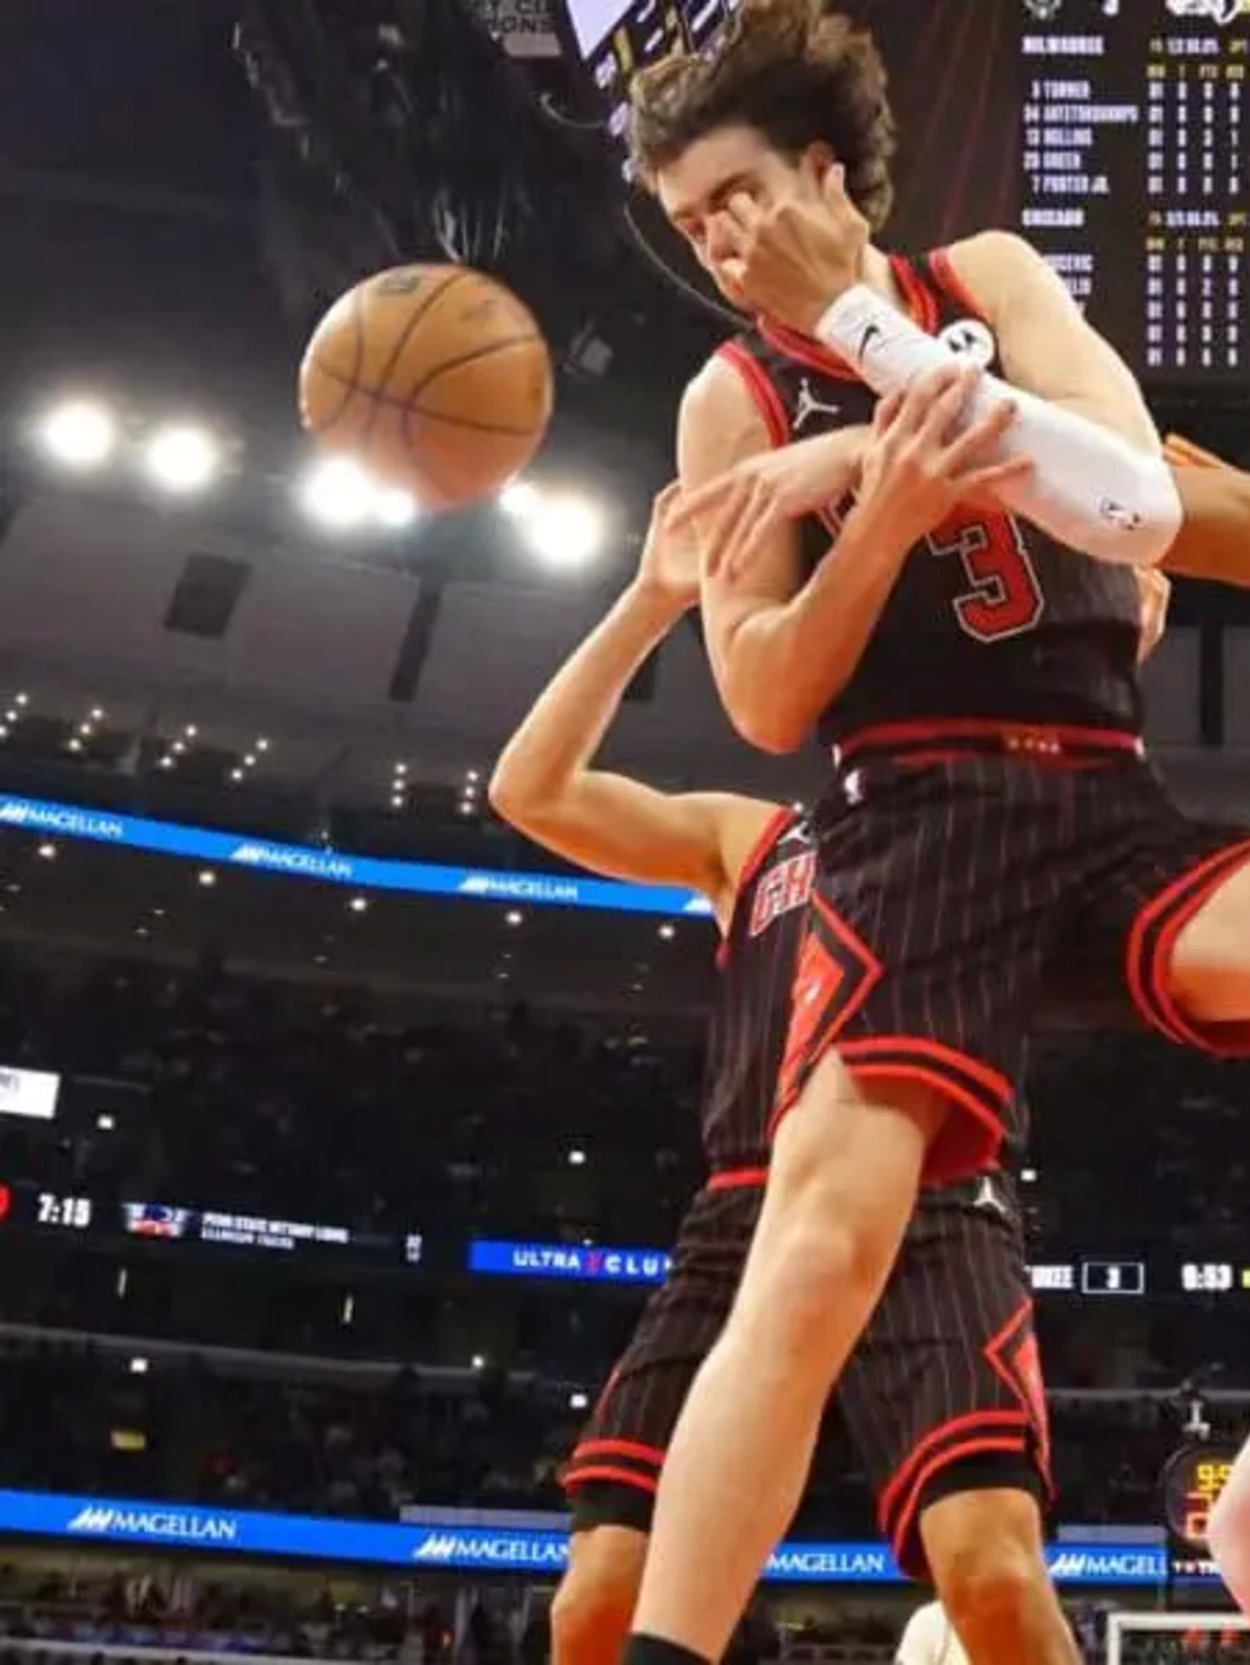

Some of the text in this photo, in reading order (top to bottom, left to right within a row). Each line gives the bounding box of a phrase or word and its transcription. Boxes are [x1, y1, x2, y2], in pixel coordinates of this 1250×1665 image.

[1022, 36, 1104, 54] MILWAUKEE
[1043, 81, 1090, 98] TURNER
[1043, 105, 1139, 122] ANTETOMPO
[1022, 209, 1084, 226] CHICAGO
[925, 500, 1045, 643] 3
[28, 807, 124, 836] MAGELLAN
[261, 847, 354, 876] MAGELLAN
[486, 878, 578, 900] MAGELLAN
[38, 1194, 91, 1227] 7:15
[512, 1248, 581, 1269] ULTRA
[112, 1512, 237, 1541] MAGELLAN
[767, 1552, 884, 1573] MAGELLAN
